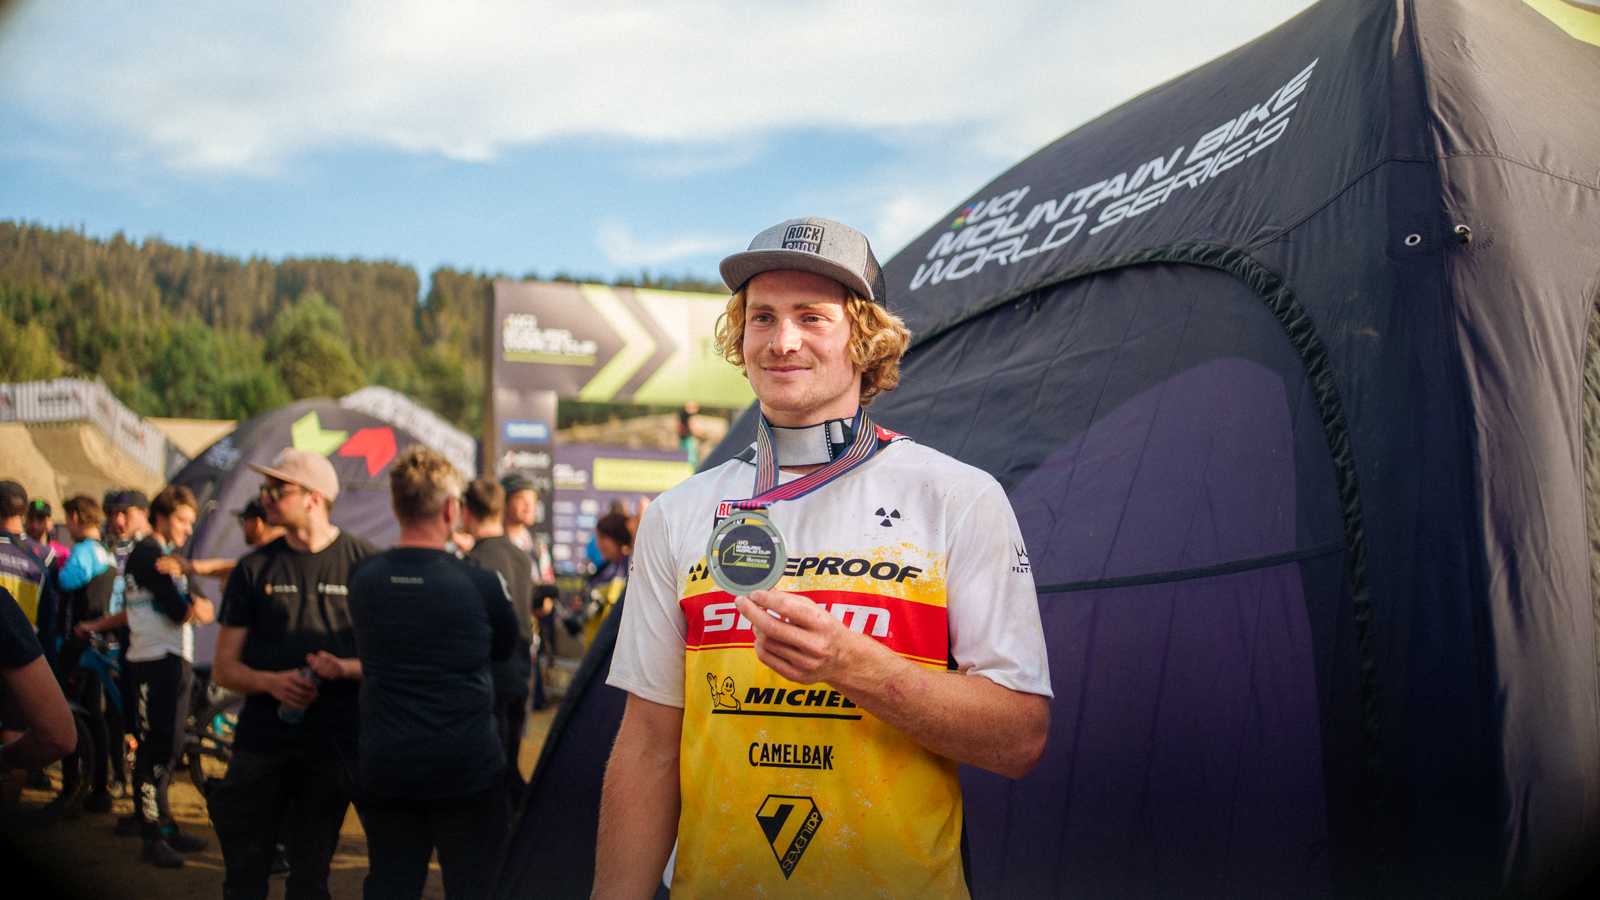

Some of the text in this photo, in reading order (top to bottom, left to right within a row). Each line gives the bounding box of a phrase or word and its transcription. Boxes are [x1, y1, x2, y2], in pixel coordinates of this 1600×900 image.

[926, 57, 1320, 260] MOUNTAIN BIKE
[909, 101, 1299, 291] WORLD SERIES
[965, 185, 1031, 225] UCI
[788, 226, 820, 241] ROCK
[701, 557, 922, 583] EPROOF
[703, 602, 890, 638] SM
[744, 687, 861, 708] MICHEL
[748, 742, 834, 770] CAMELBAK
